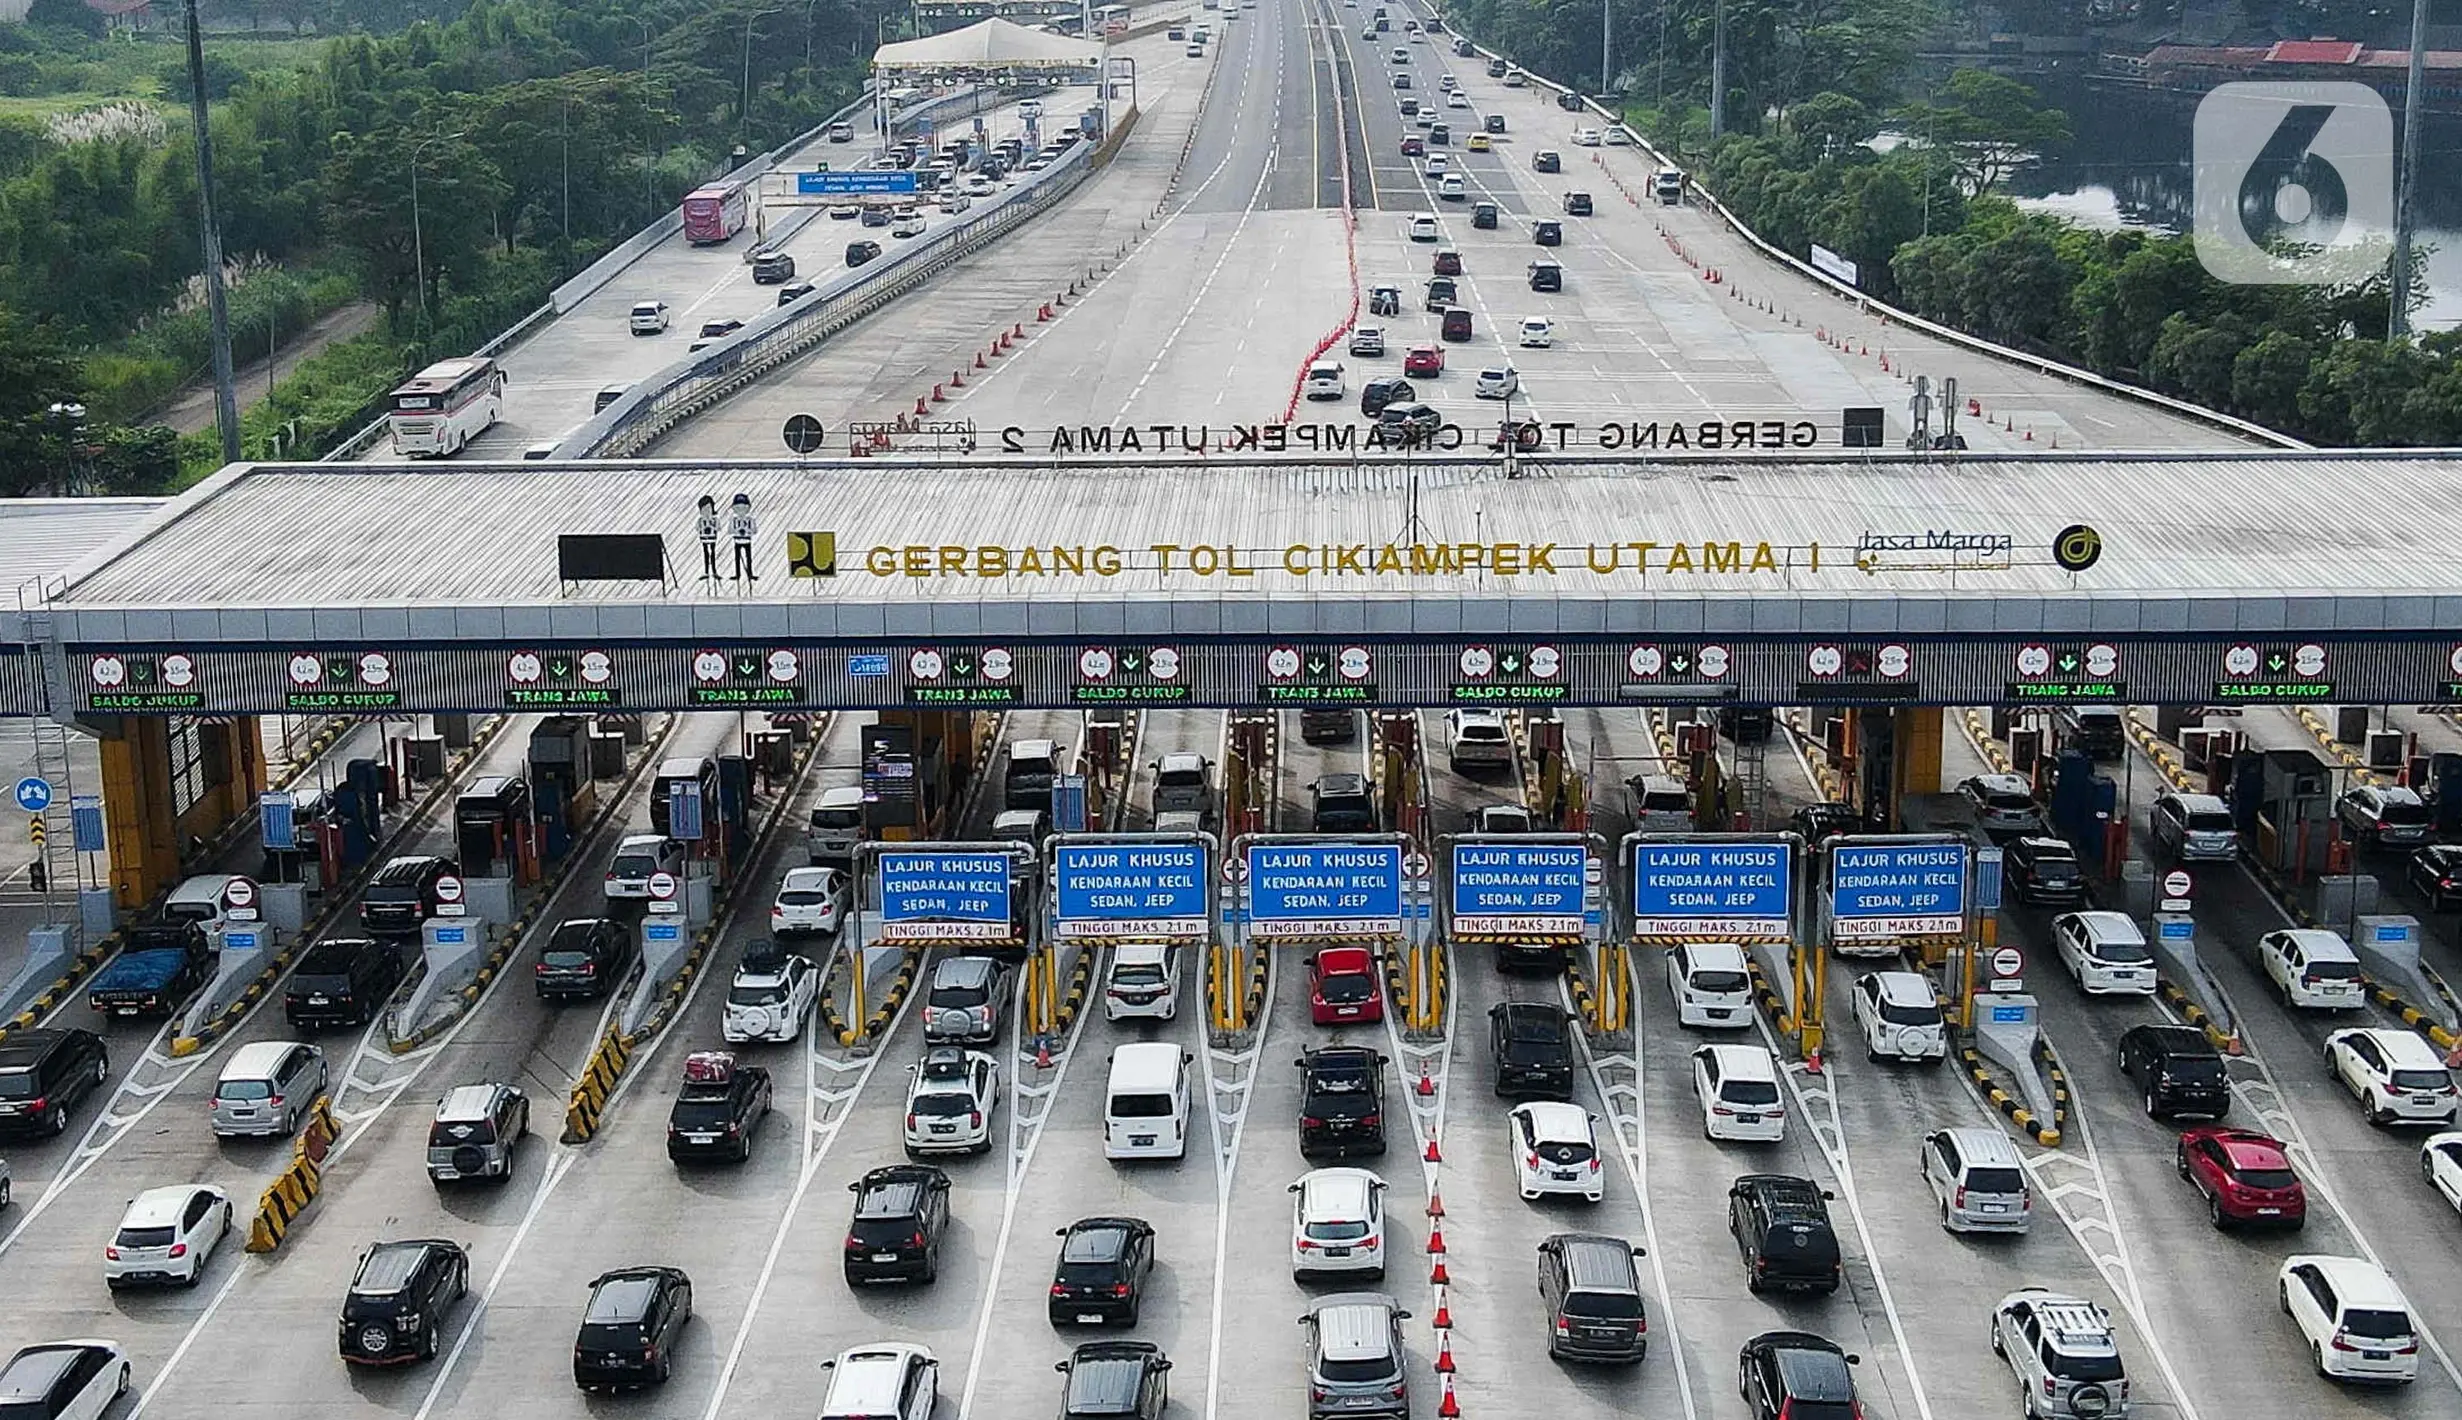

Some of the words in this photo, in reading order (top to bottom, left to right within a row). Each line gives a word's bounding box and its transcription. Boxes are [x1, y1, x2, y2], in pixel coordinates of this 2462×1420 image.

[1859, 530, 1915, 551] Jasa
[1927, 529, 2012, 556] Marga
[866, 544, 1123, 577] GERBANG
[1149, 543, 1255, 576] TOL
[1283, 542, 1558, 575] CIKAMPEK
[1588, 542, 1779, 575] UTAMA
[1068, 854, 1119, 868] LAJUR
[1130, 853, 1194, 867] KHUSUS
[1262, 853, 1312, 868] LAJUR
[1323, 853, 1388, 867] KHUSUS
[1460, 852, 1510, 866] LAJUR
[1517, 853, 1580, 866] KHUSUS
[1649, 853, 1701, 867] LAJUR
[1711, 852, 1777, 867] KHUSUS
[1839, 853, 1889, 868] LAJUR
[1896, 851, 1959, 867] KHUSUS
[886, 860, 935, 873] LAJUR
[942, 860, 1003, 873] KHUSUS
[886, 879, 966, 893] KENDARAAN
[970, 880, 1004, 893] KECIL
[1069, 875, 1151, 889] KENDARAAN
[1158, 874, 1194, 888] KECIL
[1262, 875, 1344, 889] KENDARAAN
[1352, 875, 1387, 888] KECIL
[1459, 873, 1539, 886] KENDARAAN
[1545, 874, 1580, 886] KECIL
[1649, 874, 1733, 888] KENDARAAN
[1739, 874, 1776, 887] KECIL
[1838, 873, 1917, 889] KENDARAAN
[1924, 872, 1958, 886] KECIL
[902, 898, 951, 912] SEDAN,
[958, 899, 989, 913] JEEP
[1144, 894, 1175, 907] JEEP
[1337, 894, 1369, 907] JEEP
[1478, 893, 1526, 906] SEDAN,
[1530, 893, 1562, 906] JEEP
[1724, 893, 1756, 906] JEEP
[1857, 894, 1905, 908] SEDAN,
[1909, 893, 1940, 907] JEEP
[888, 924, 930, 936] TINGGI
[1071, 922, 1115, 933] TINGGI
[1262, 922, 1306, 934] TINGGI
[1460, 919, 1502, 931] TINGGI
[1648, 921, 1692, 932] TINGGI
